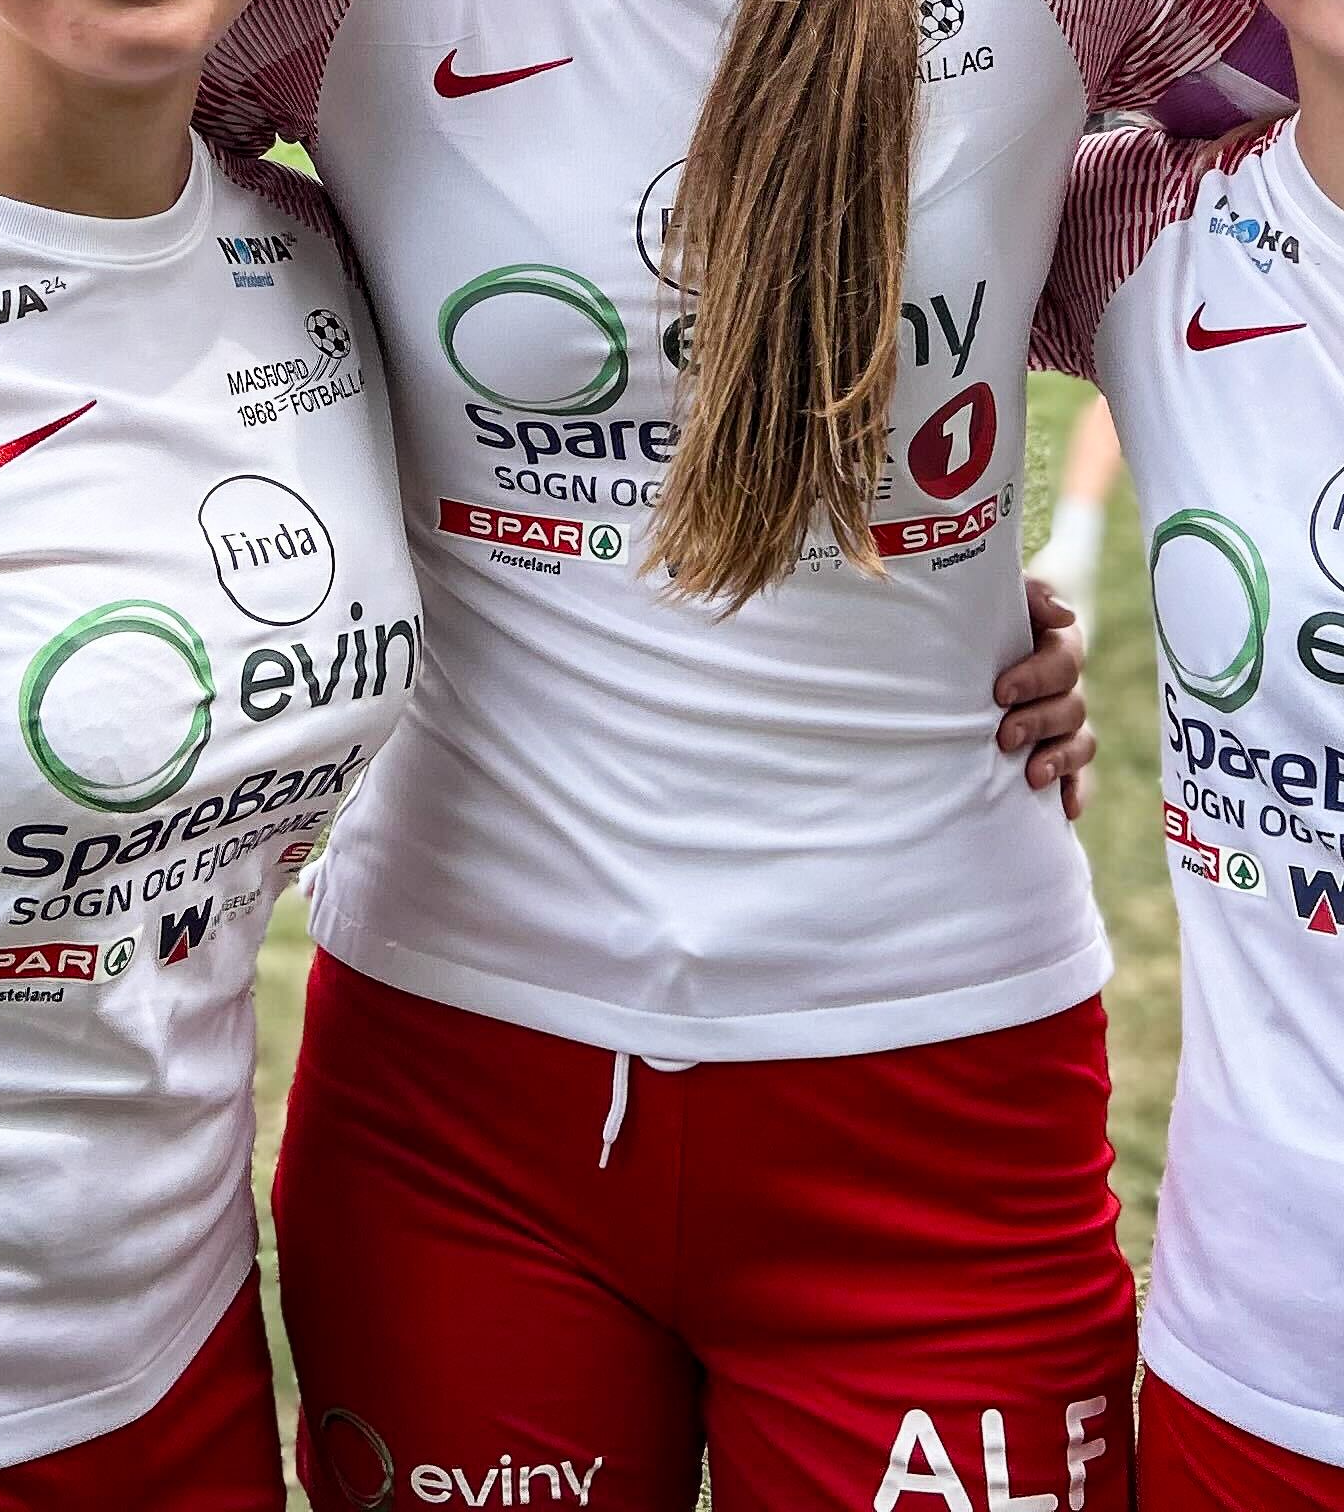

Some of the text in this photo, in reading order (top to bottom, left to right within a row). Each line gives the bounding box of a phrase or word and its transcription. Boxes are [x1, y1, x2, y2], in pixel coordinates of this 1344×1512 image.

[227, 358, 309, 396] MASFJORD
[237, 400, 278, 428] 1968
[942, 401, 974, 476] 1
[494, 466, 598, 504] SOGN
[221, 523, 318, 571] Firda
[469, 510, 579, 551] SPAR
[902, 501, 997, 550] SPAR
[489, 549, 561, 575] Hosteland
[241, 601, 423, 723] evin
[1, 744, 366, 891] SpareBank
[1176, 778, 1246, 830] OGN
[8, 879, 133, 926] SOGN
[142, 859, 187, 902] OG
[410, 1454, 603, 1507] eviny
